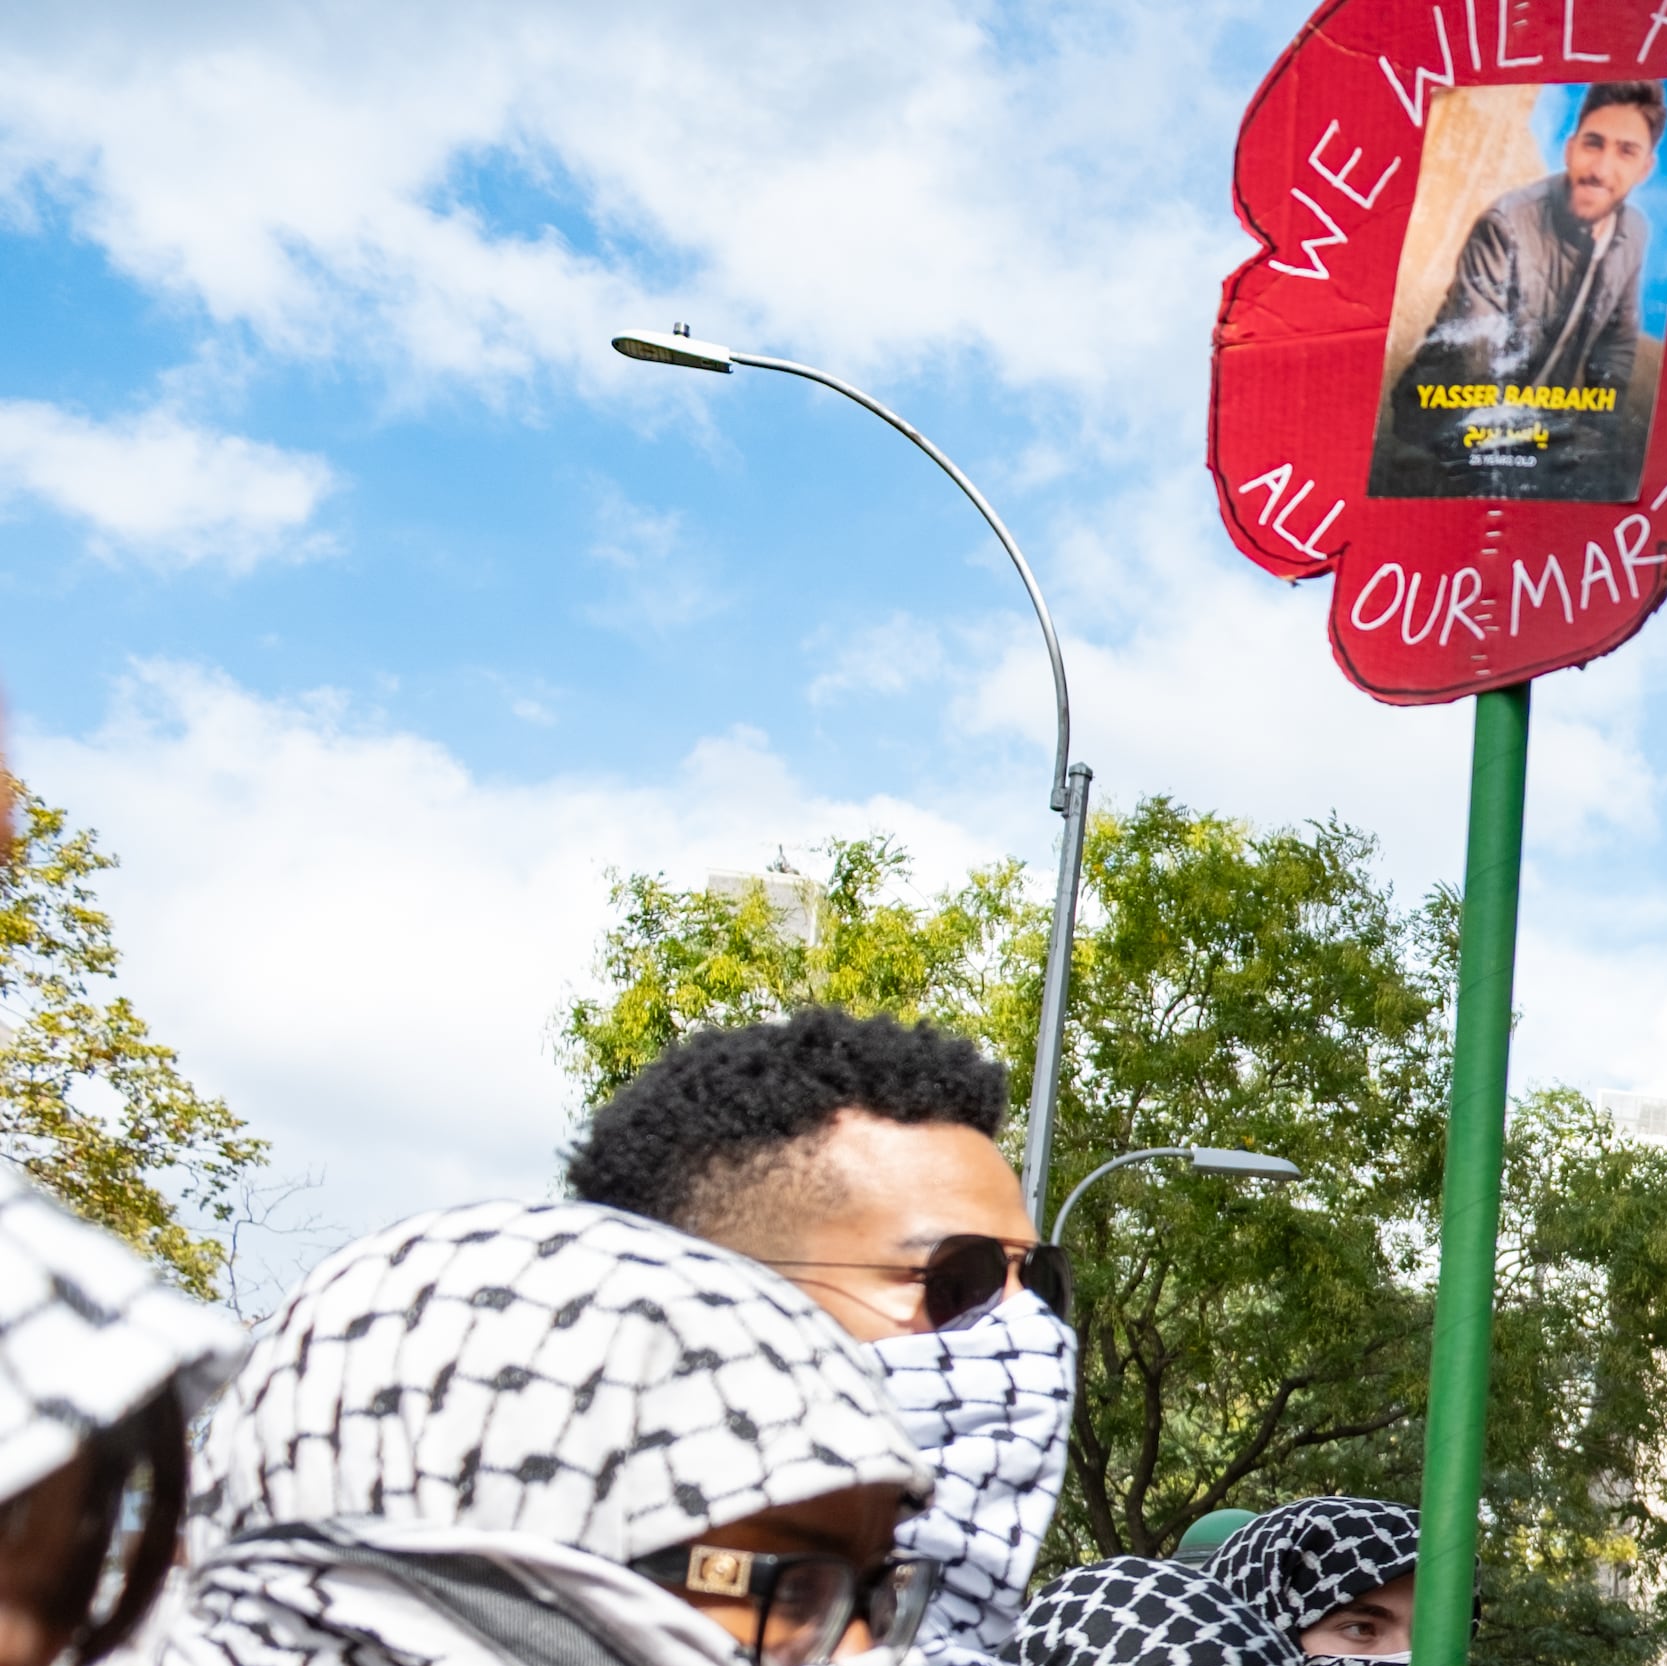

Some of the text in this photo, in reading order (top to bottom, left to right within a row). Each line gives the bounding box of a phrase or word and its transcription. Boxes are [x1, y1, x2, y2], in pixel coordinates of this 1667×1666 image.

[1269, 118, 1401, 281] WE
[1378, 0, 1611, 127] WILL
[1417, 385, 1617, 412] YASSER BARBAKH
[1239, 462, 1346, 561] ALL
[1351, 562, 1486, 646] OUR
